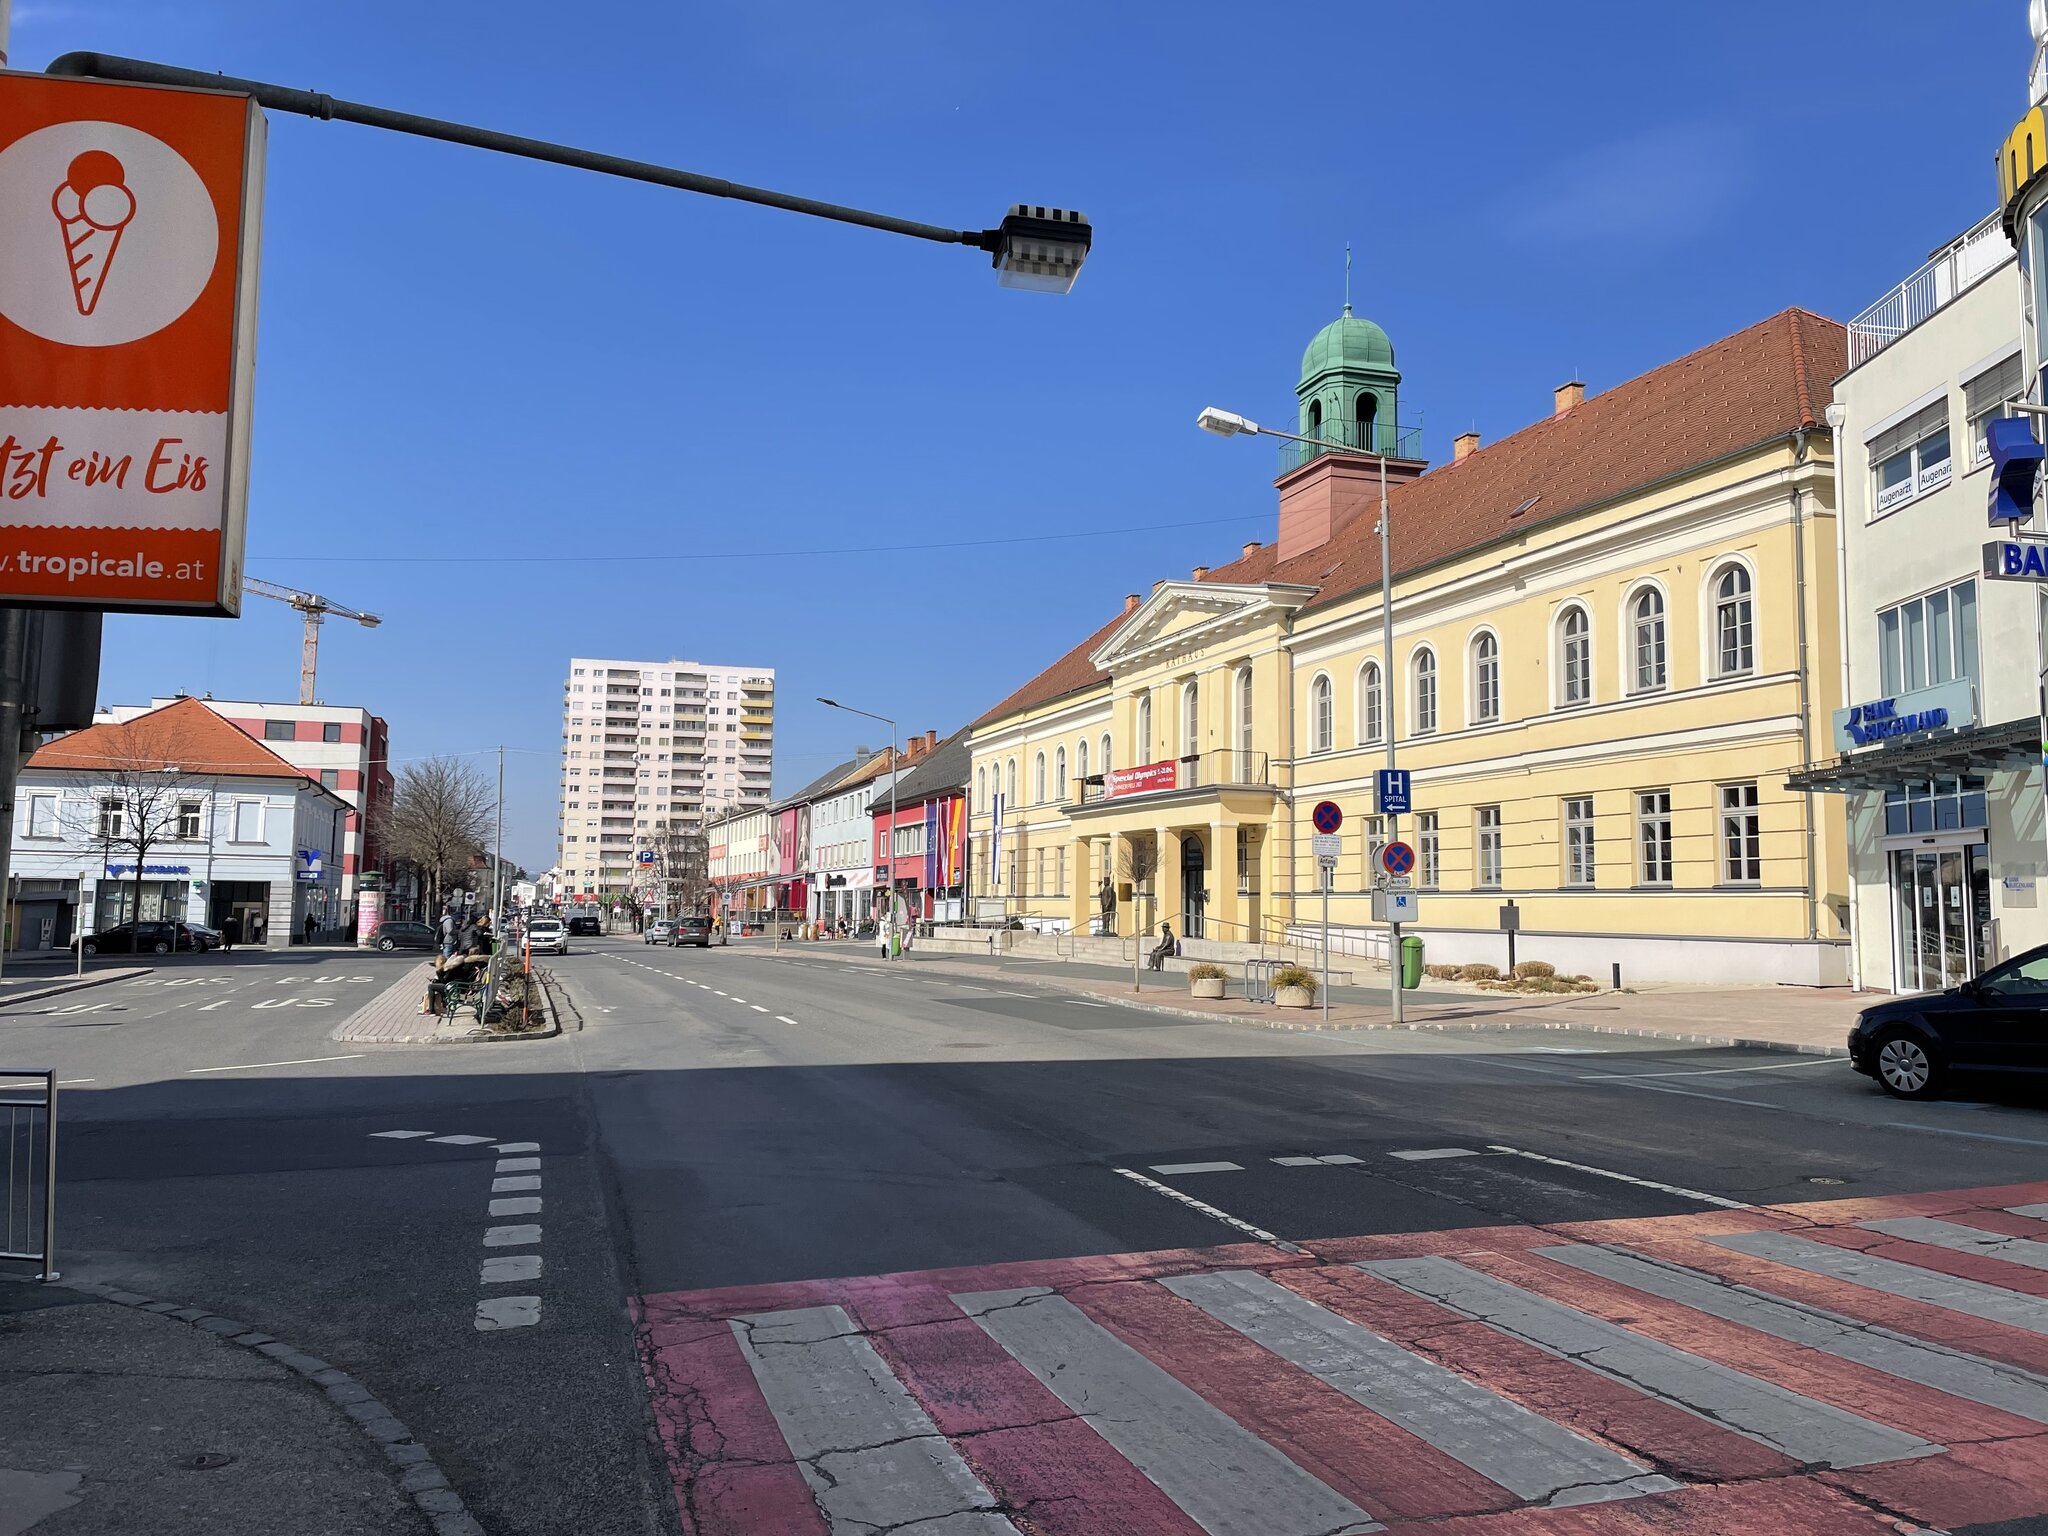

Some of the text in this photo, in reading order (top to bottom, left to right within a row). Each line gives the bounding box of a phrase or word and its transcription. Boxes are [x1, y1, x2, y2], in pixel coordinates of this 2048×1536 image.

[68, 450, 132, 490] ein
[144, 437, 209, 494] Eis
[1879, 480, 1912, 506] Augenarzt
[2004, 543, 2048, 577] BA
[1863, 698, 1896, 722] BANK
[1864, 708, 1948, 742] BURGENLAND
[1113, 771, 1134, 783] Special
[1135, 769, 1157, 780] Olympics
[1387, 772, 1402, 794] H
[1384, 796, 1407, 804] SPITAL
[642, 852, 651, 862] P
[1320, 857, 1336, 866] Anfang
